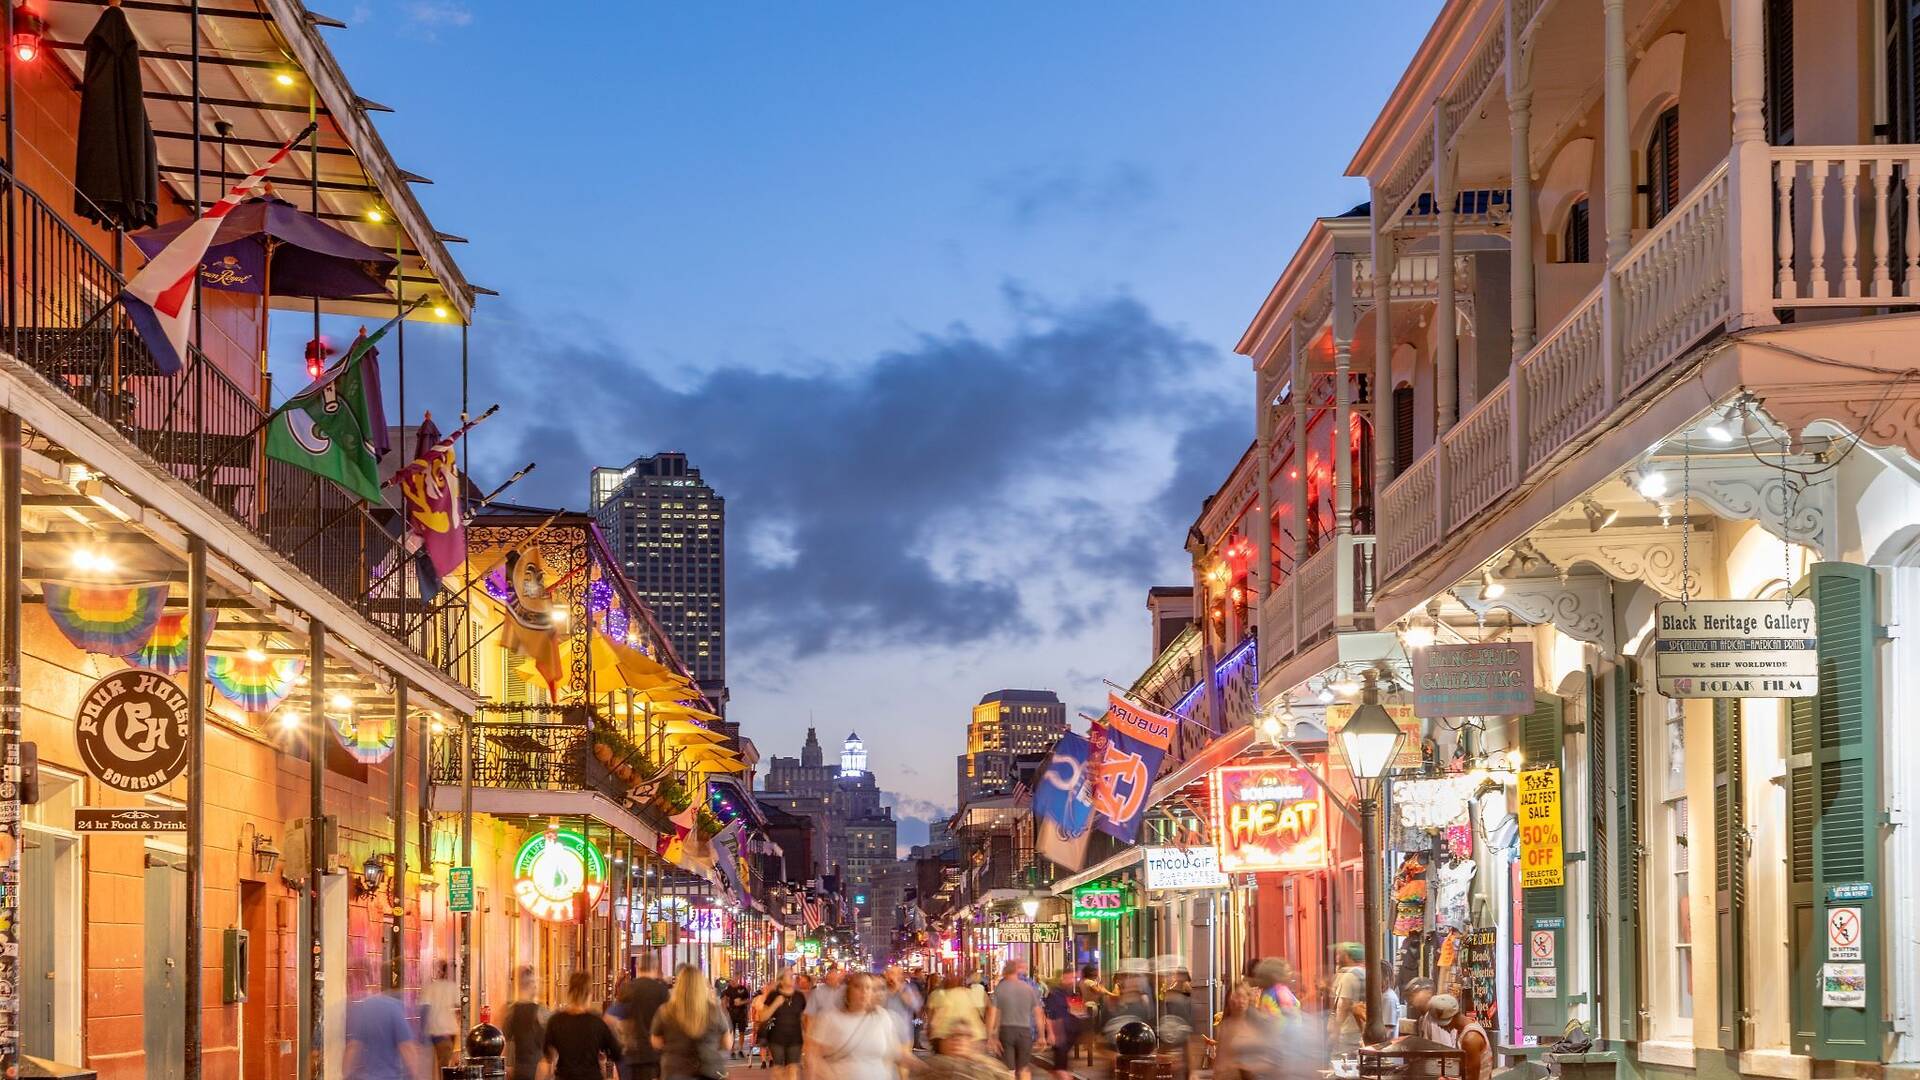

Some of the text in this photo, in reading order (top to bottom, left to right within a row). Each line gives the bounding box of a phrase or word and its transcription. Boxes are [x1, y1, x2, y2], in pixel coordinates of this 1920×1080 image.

[1662, 614, 1810, 635] Black Heritage Gallery
[1668, 639, 1806, 652] SPECIALIZING IN AFRICAN-AMERICAN PRINTS
[1421, 670, 1490, 690] GALLERY
[1700, 680, 1803, 692] KODAK FILM
[79, 679, 127, 736] POUR
[102, 767, 168, 790] BOURBON
[1521, 791, 1556, 805] JAZZ FEST
[1528, 806, 1550, 819] SALE
[78, 820, 94, 829] 24
[95, 820, 109, 829] hr
[111, 820, 139, 829] Food
[141, 820, 151, 829] &
[1229, 800, 1320, 850] HEAT
[1523, 824, 1559, 846] 50%
[521, 856, 532, 870] LIVE
[530, 840, 546, 857] LIFE
[1528, 848, 1553, 866] OFF
[1149, 858, 1189, 870] TRICOU
[1526, 869, 1558, 878] SELECTED
[1523, 877, 1561, 887] ITEMS ONLY
[1853, 889, 1868, 897] STEPS
